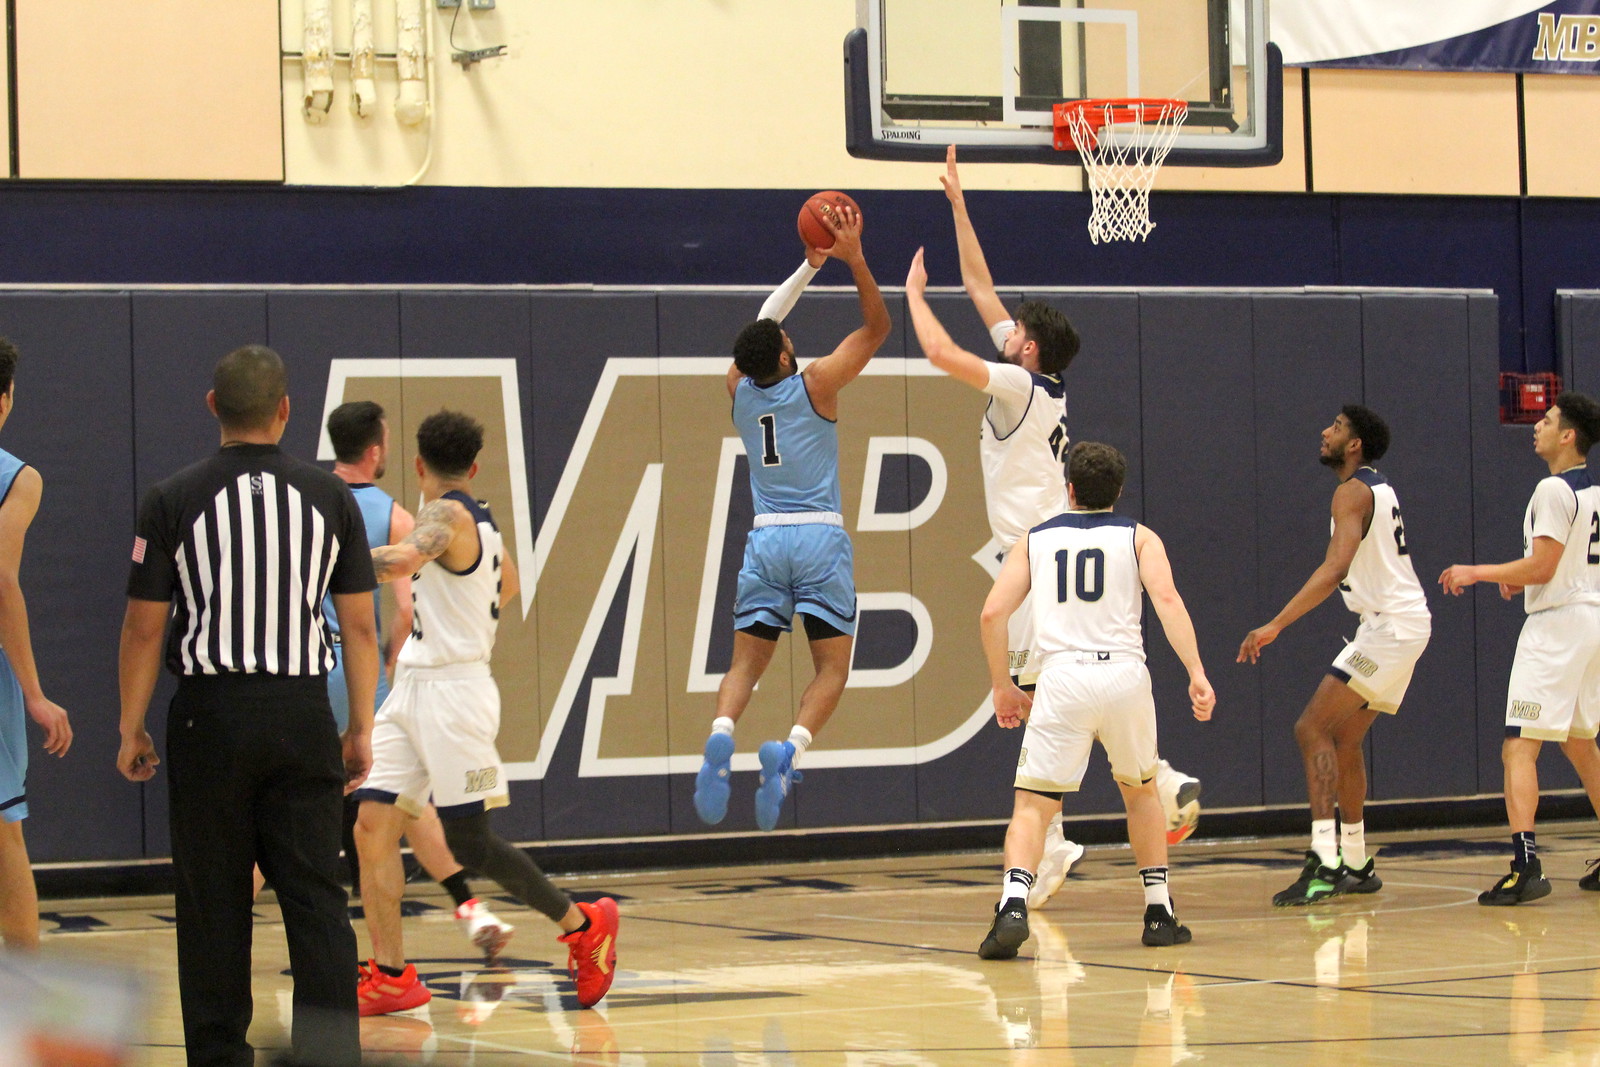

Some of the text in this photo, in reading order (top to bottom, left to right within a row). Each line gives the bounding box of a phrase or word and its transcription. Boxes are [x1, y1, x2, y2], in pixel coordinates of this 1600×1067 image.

[1532, 12, 1600, 61] MB
[881, 130, 920, 140] SPALDING
[758, 413, 781, 467] 1
[317, 357, 1010, 779] MB
[1055, 548, 1104, 603] 10
[1345, 651, 1379, 678] MB
[1509, 700, 1541, 720] MB
[464, 766, 497, 792] MB
